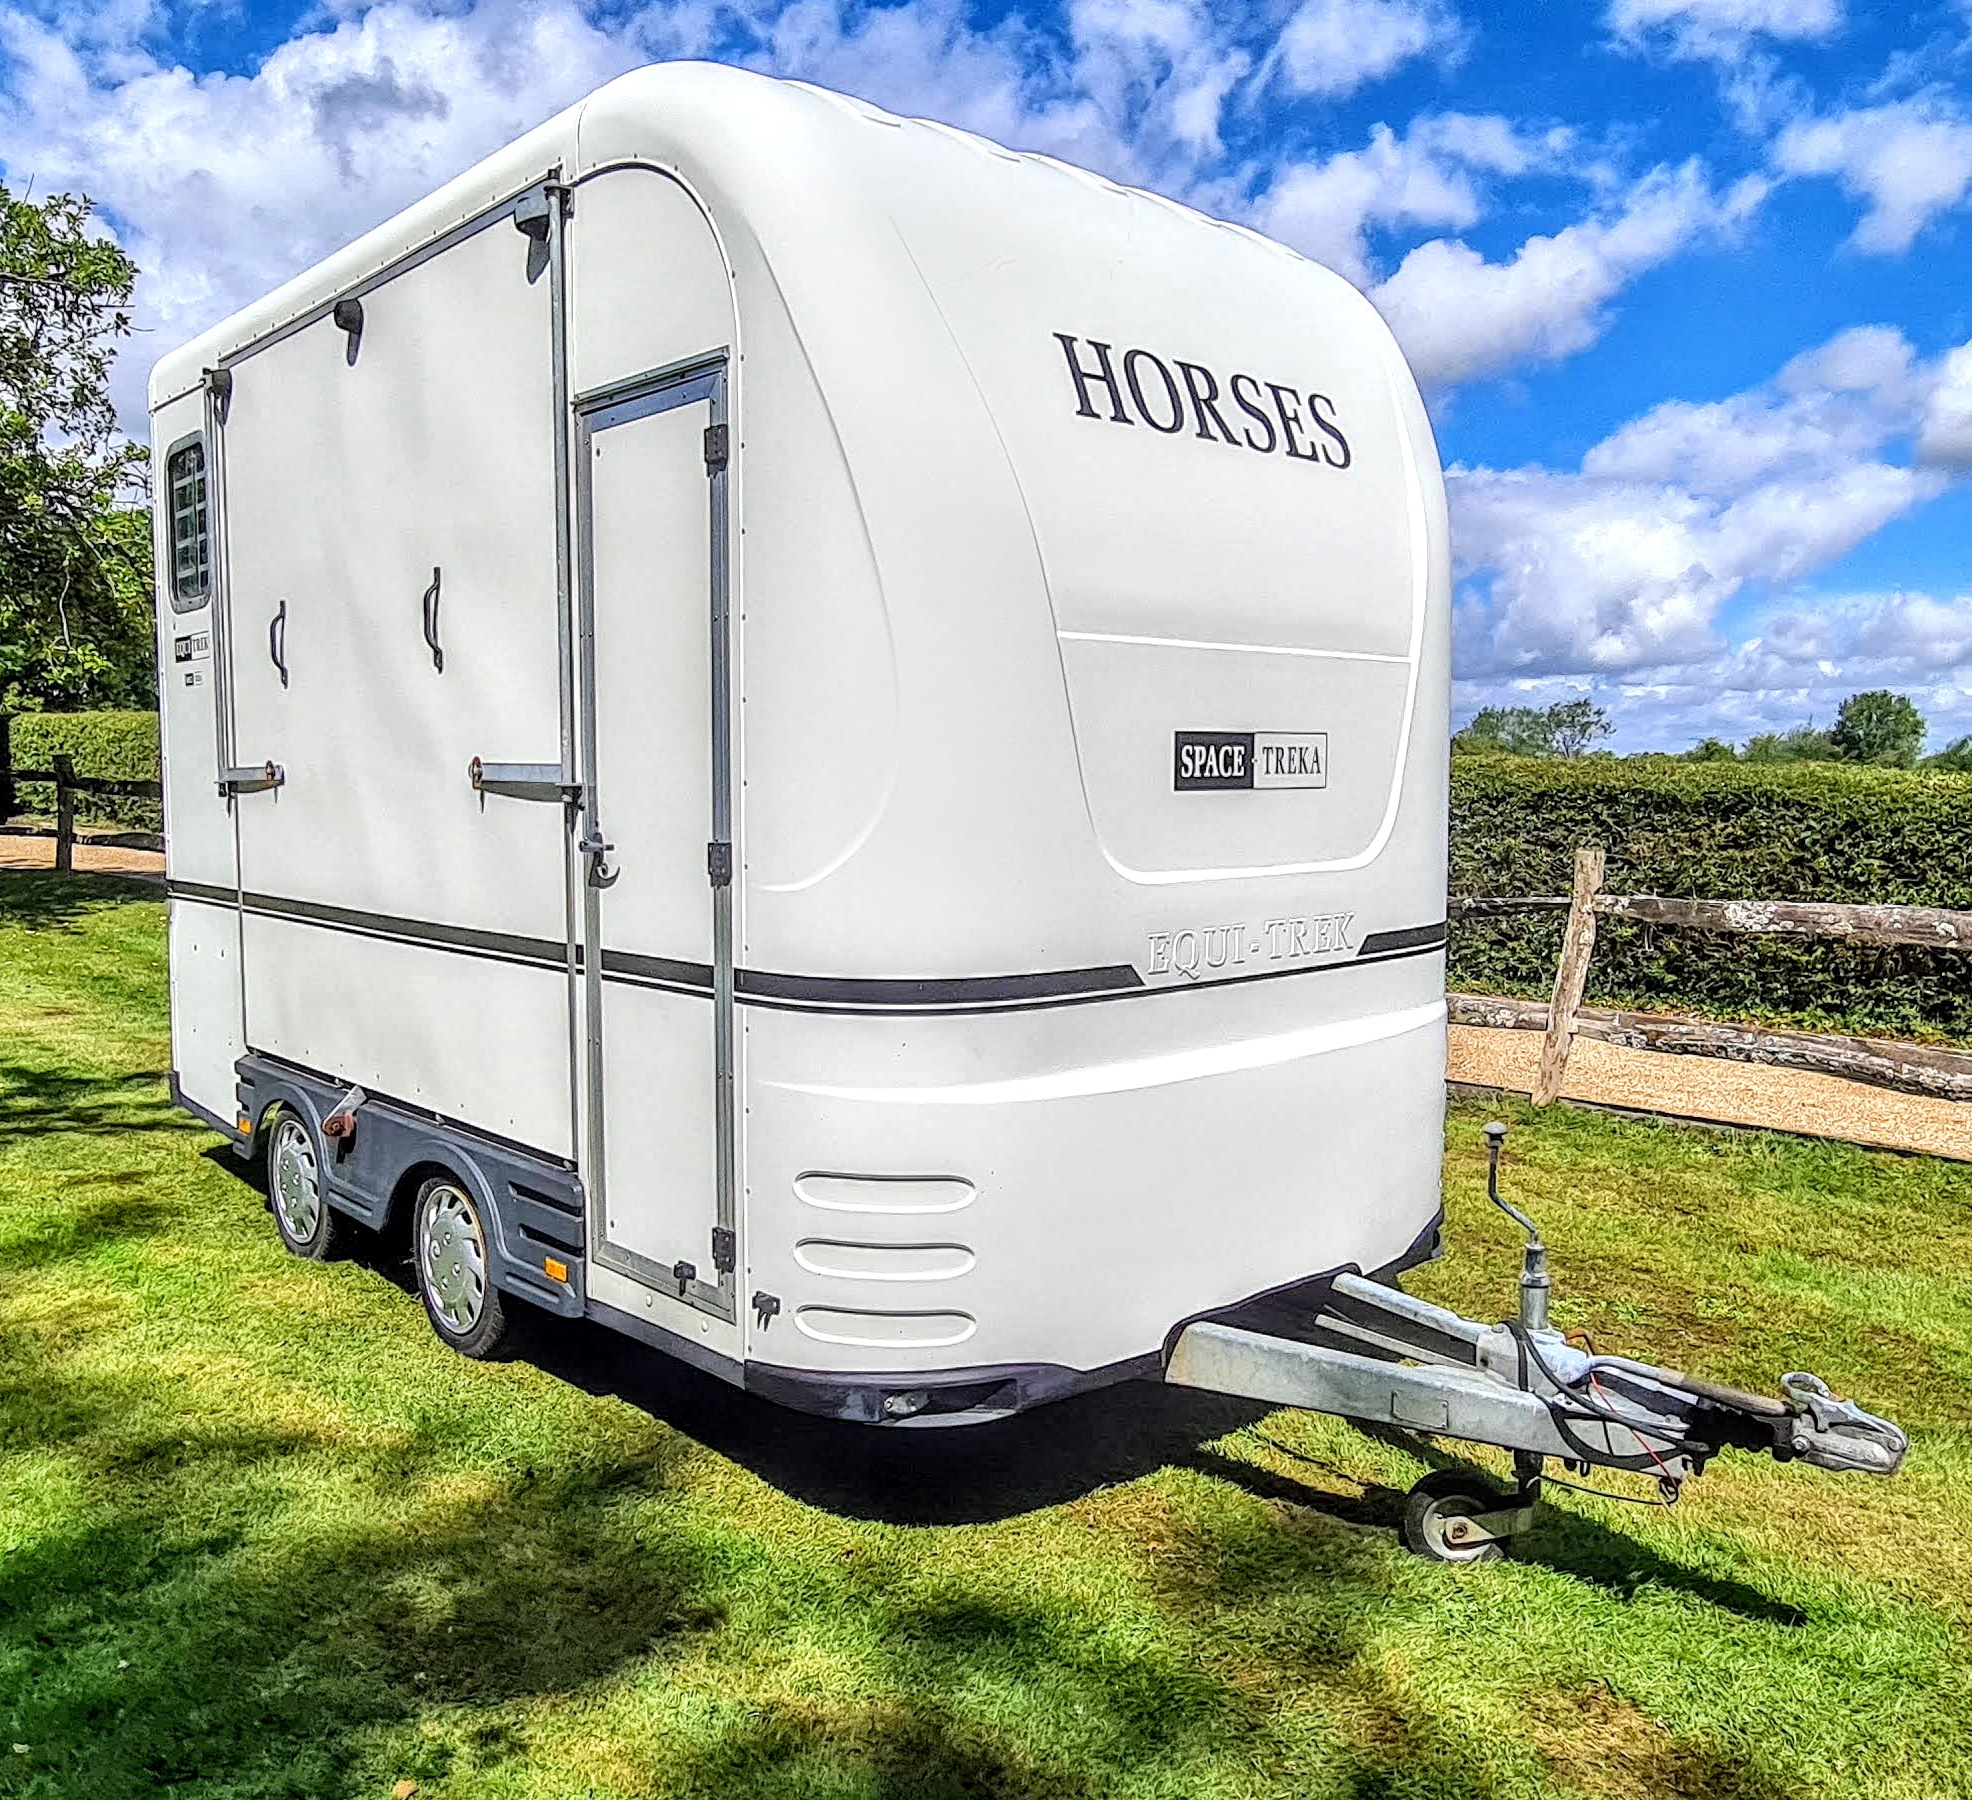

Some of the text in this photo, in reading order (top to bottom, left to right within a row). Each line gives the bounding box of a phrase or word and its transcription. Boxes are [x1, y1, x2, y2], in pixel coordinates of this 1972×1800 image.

[1052, 332, 1351, 469] HORSES
[1180, 744, 1321, 778] SPACE TREKA
[1146, 911, 1355, 980] EQUI-TREK
